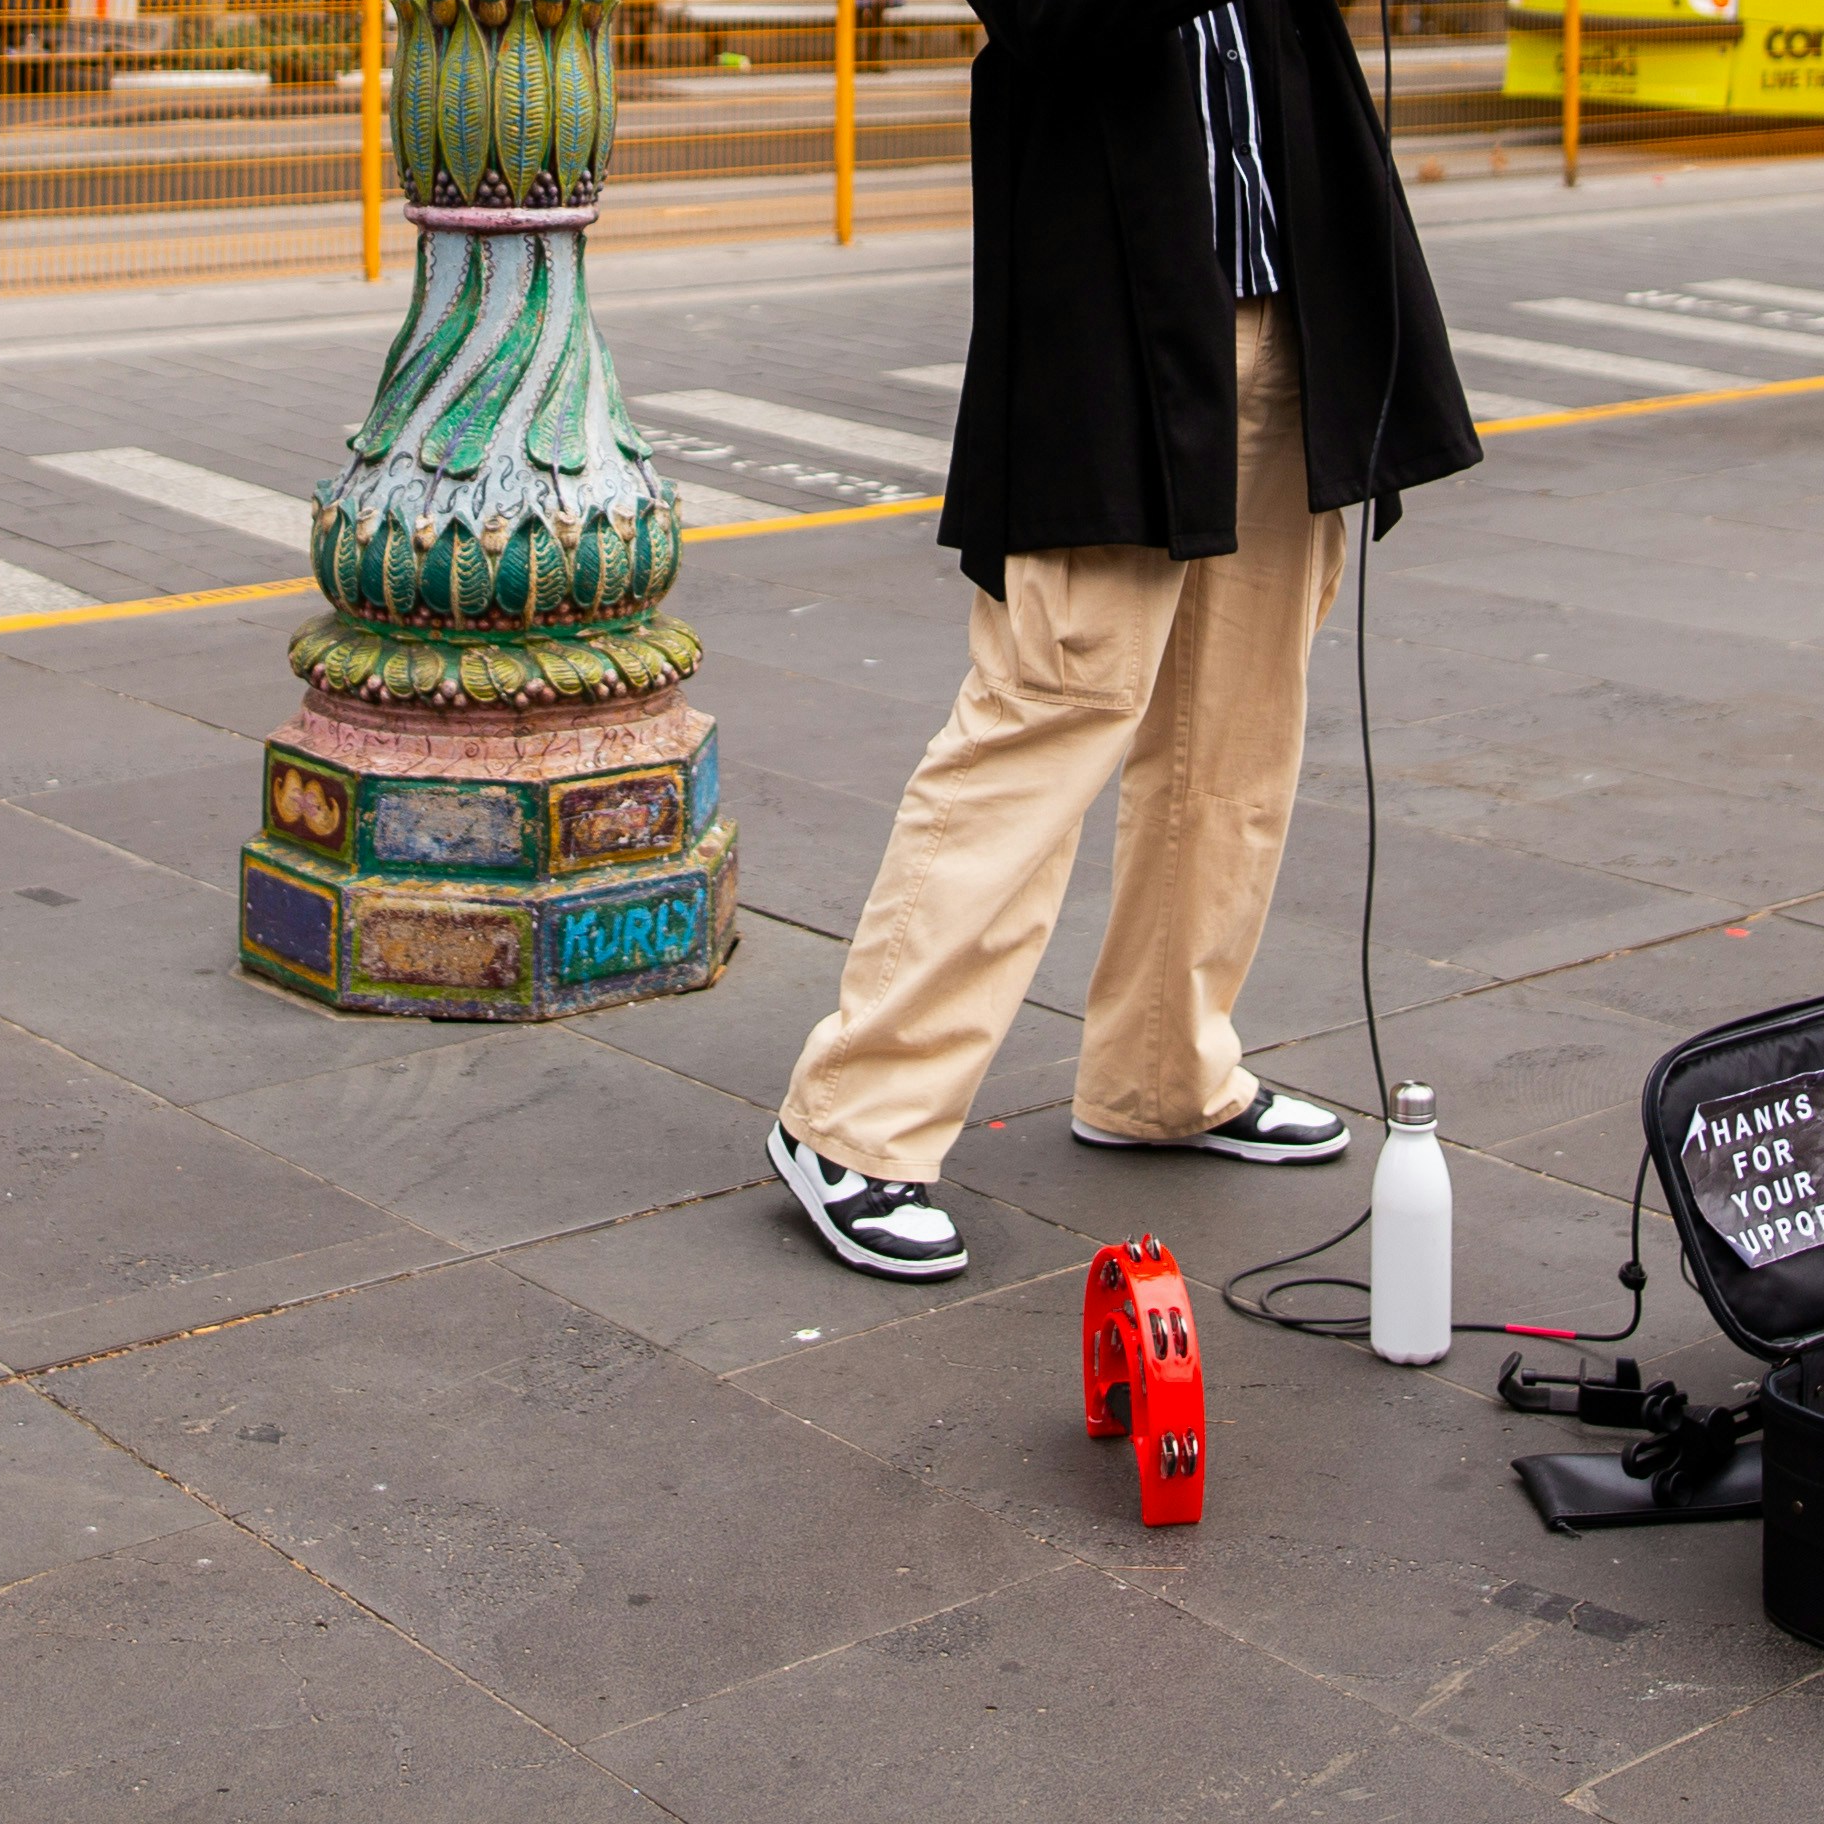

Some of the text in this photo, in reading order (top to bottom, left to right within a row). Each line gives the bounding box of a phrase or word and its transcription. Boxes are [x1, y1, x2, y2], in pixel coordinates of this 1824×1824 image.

[1696, 1093, 1813, 1152] THANKS
[1732, 1138, 1794, 1179] FOR
[1731, 1171, 1816, 1218] YOUR
